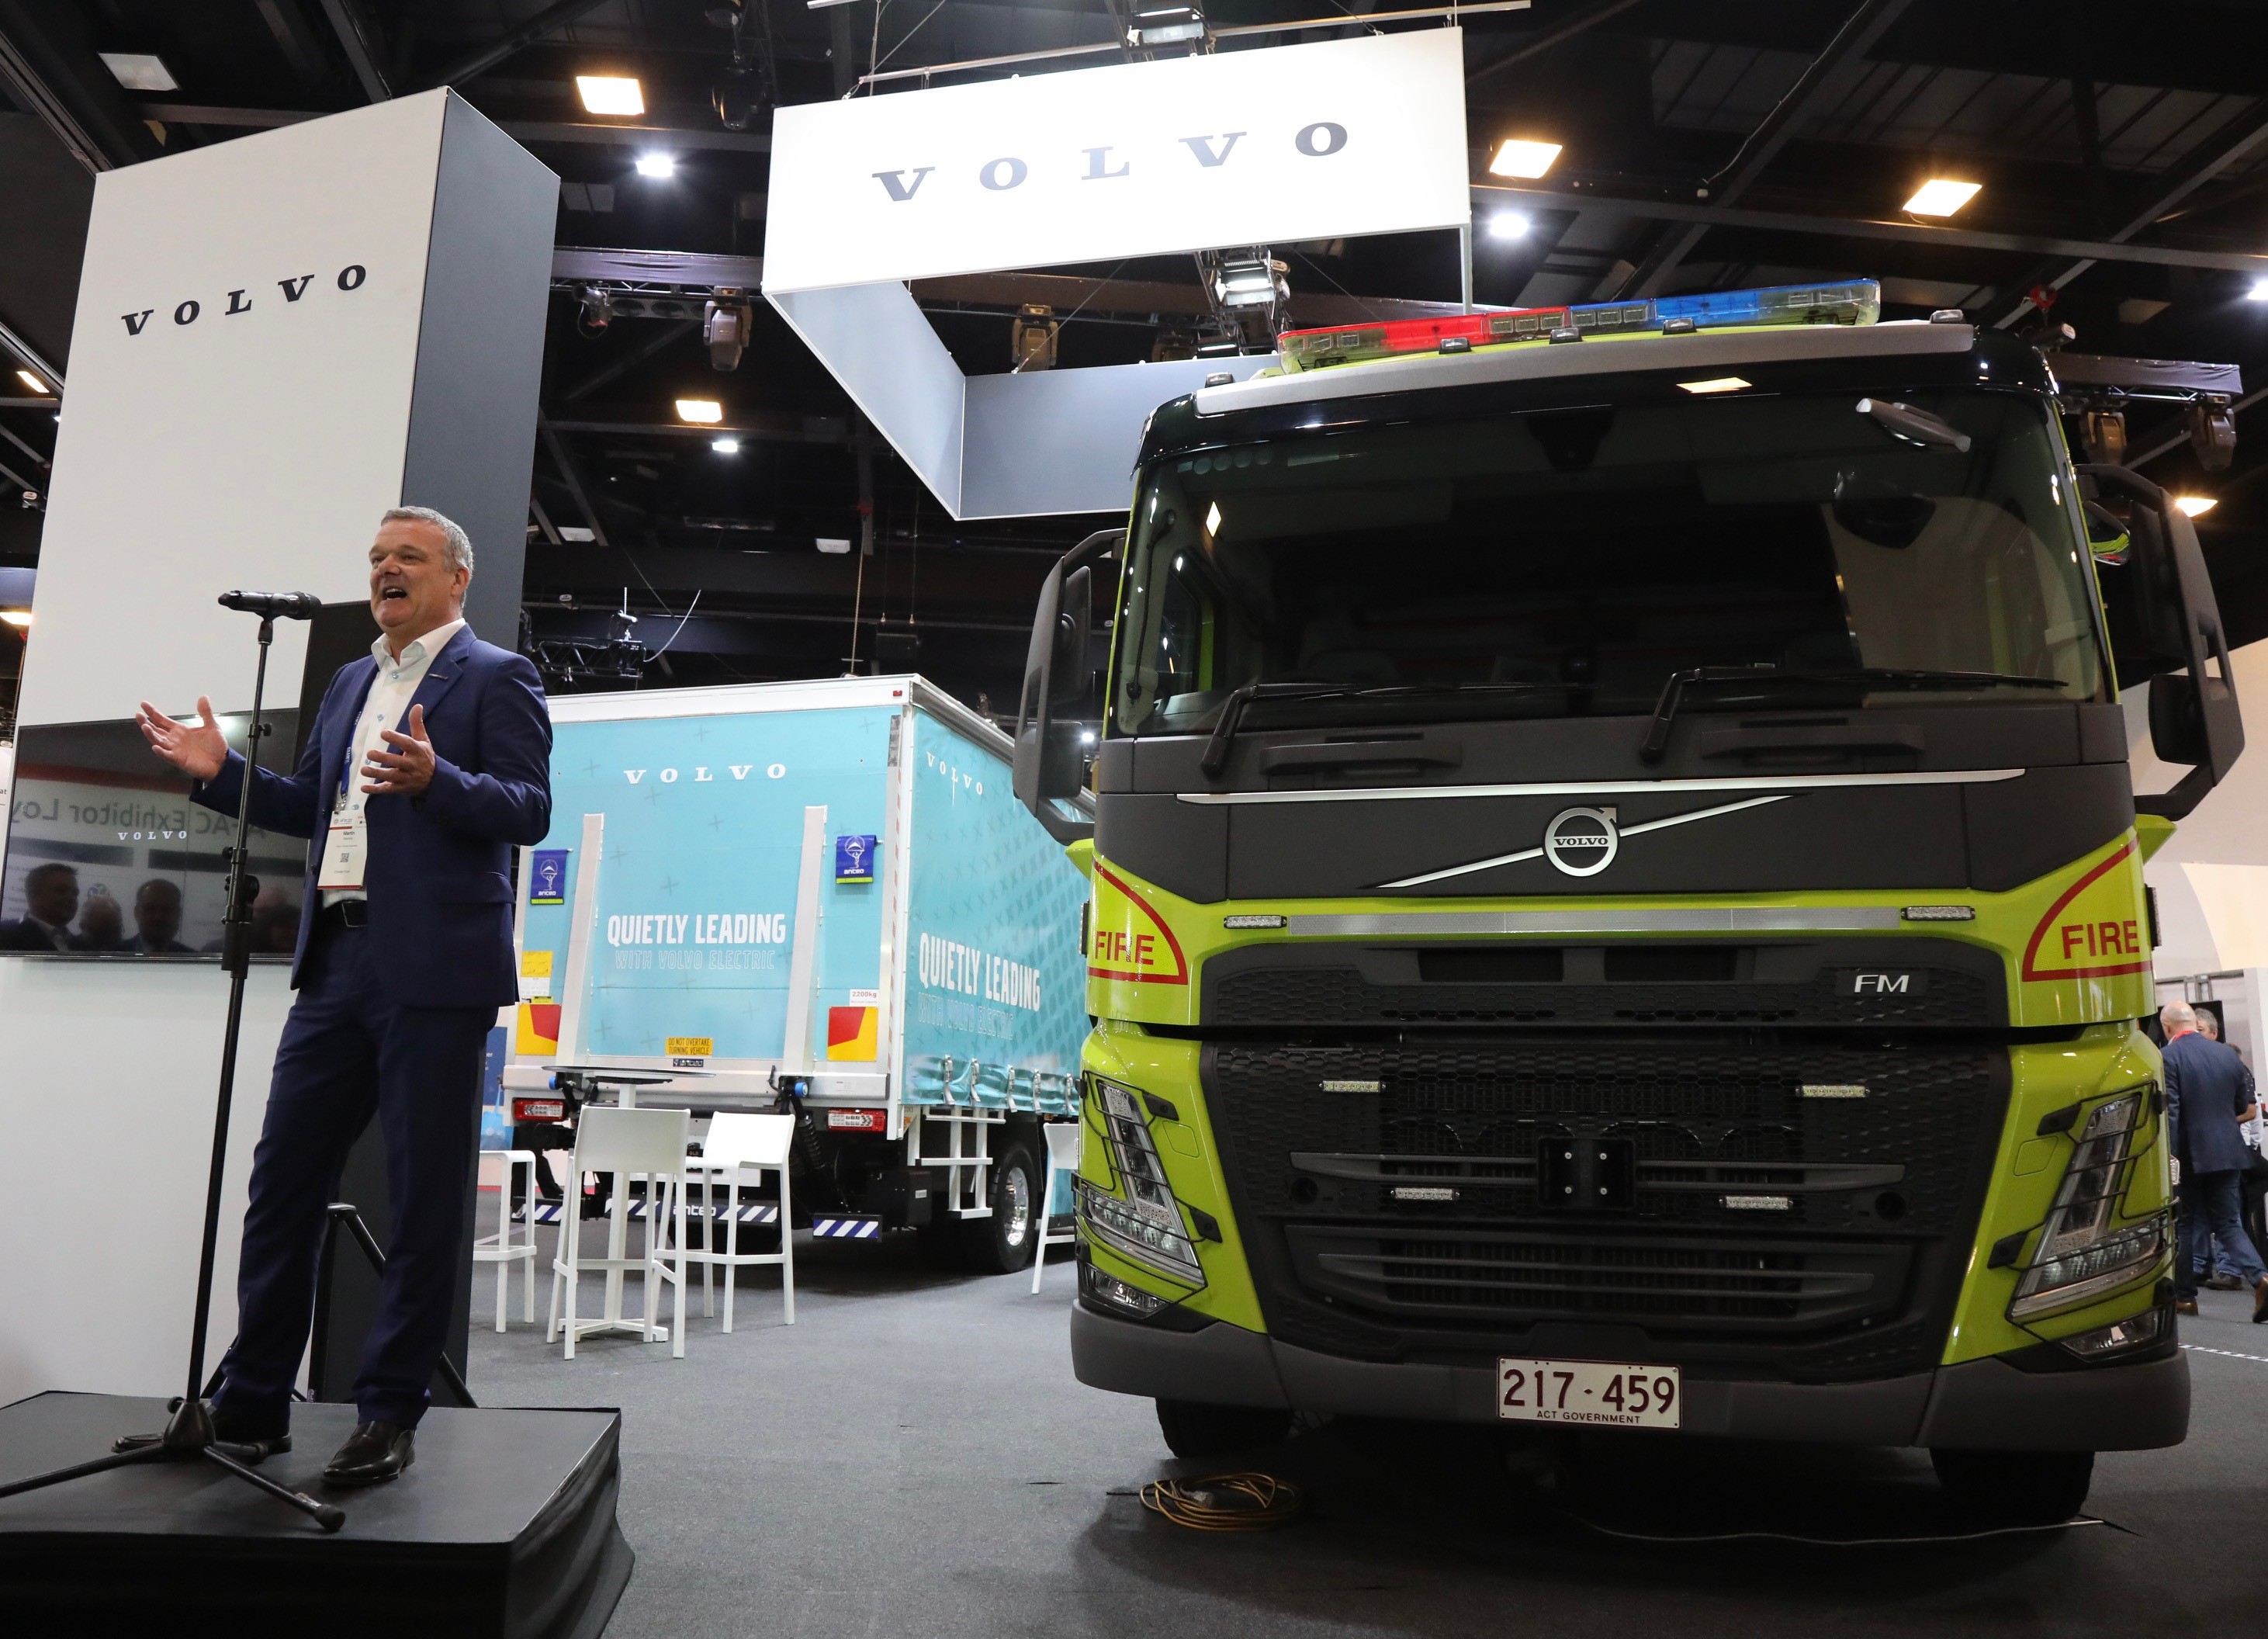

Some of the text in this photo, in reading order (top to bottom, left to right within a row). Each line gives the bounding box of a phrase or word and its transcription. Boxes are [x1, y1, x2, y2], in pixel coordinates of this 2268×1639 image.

[871, 121, 1348, 202] VOLVO
[121, 264, 366, 336] VOLVO
[623, 763, 786, 785] VOLVO
[926, 751, 982, 795] VOLVO
[118, 830, 187, 840] VOLVO
[1554, 837, 1608, 846] VOLVO
[607, 913, 787, 948] QUIETLY LEADING
[2061, 920, 2140, 960] FIRE
[1095, 930, 1155, 965] FIRE
[615, 950, 775, 970] WITH VOLVO ELECTRIC
[919, 932, 1041, 1012] QUIETLY LEADING
[1854, 974, 1910, 994] FM
[668, 1038, 710, 1046] DO NOT OVERTAKE
[669, 1046, 709, 1055] TURNING VEHICLE
[1536, 1410, 1641, 1424] ACT GOVERNMENT
